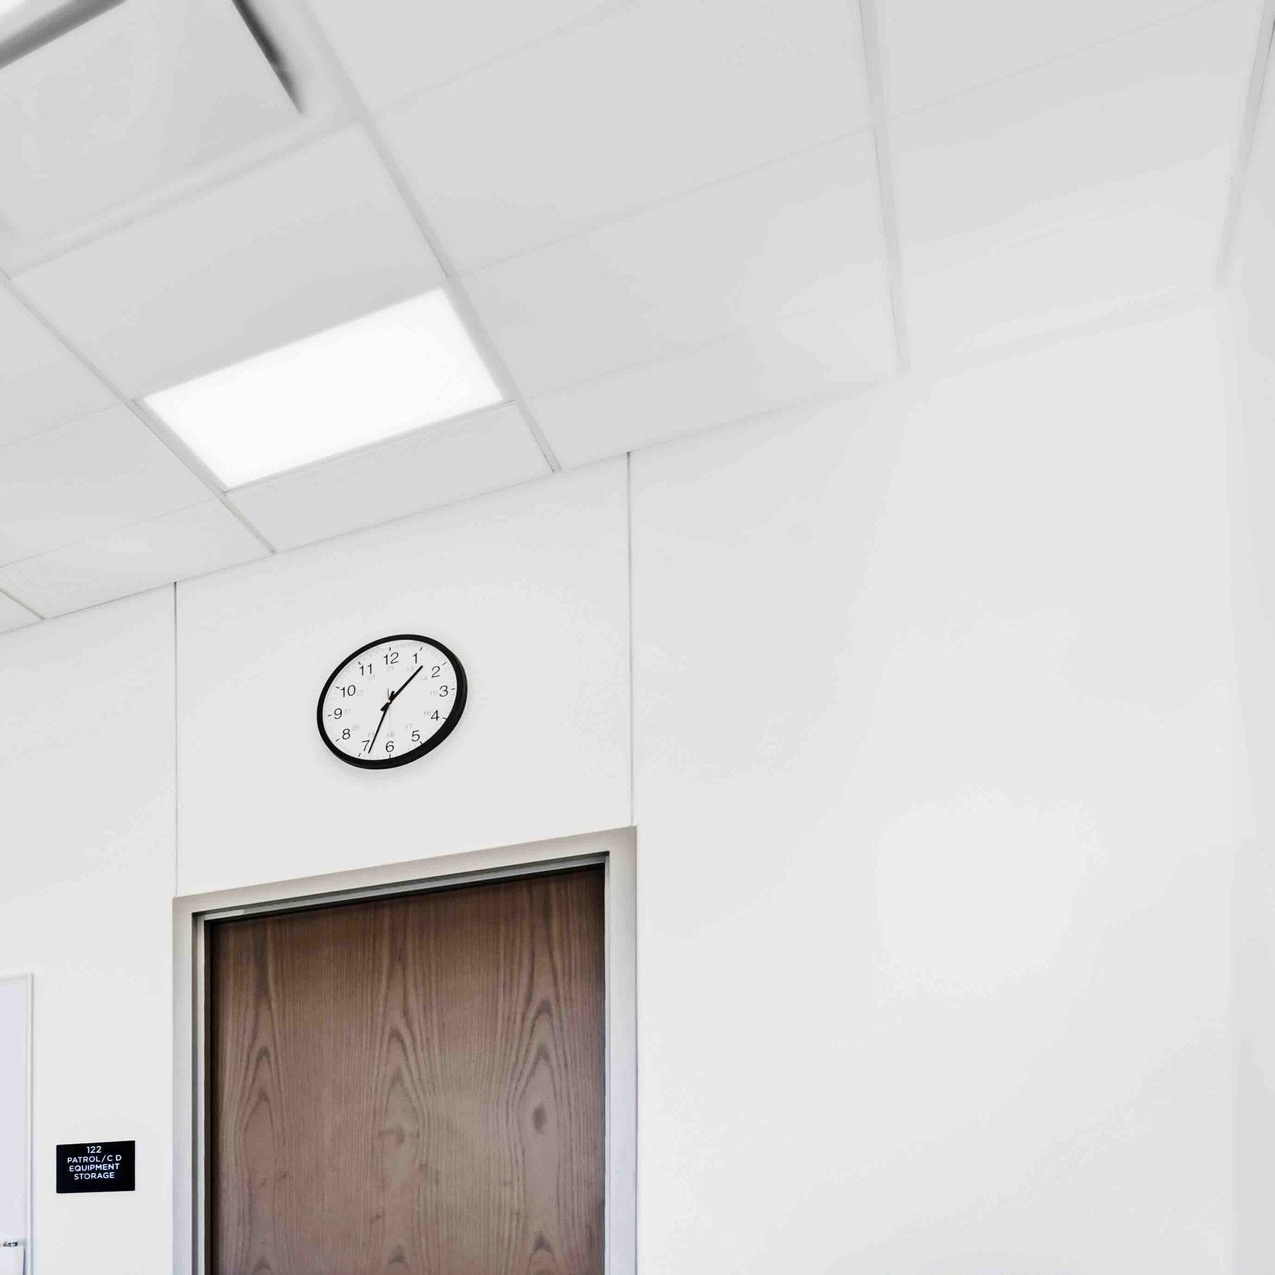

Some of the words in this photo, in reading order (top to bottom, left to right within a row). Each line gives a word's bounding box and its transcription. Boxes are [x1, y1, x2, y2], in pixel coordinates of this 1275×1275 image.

[383, 652, 399, 665] 12
[412, 653, 418, 664] 1
[359, 663, 373, 676] 11
[431, 666, 441, 678] 2
[340, 685, 356, 697] 10
[438, 685, 449, 697] 3
[333, 708, 343, 719] 9
[430, 710, 440, 721] 4
[342, 728, 351, 740] 8
[411, 730, 420, 742] 5
[361, 740, 370, 751] 7
[385, 741, 394, 752] 6
[86, 1146, 102, 1154] 122
[68, 1163, 120, 1172] EQUIPMENT
[73, 1172, 115, 1180] STORAGE
